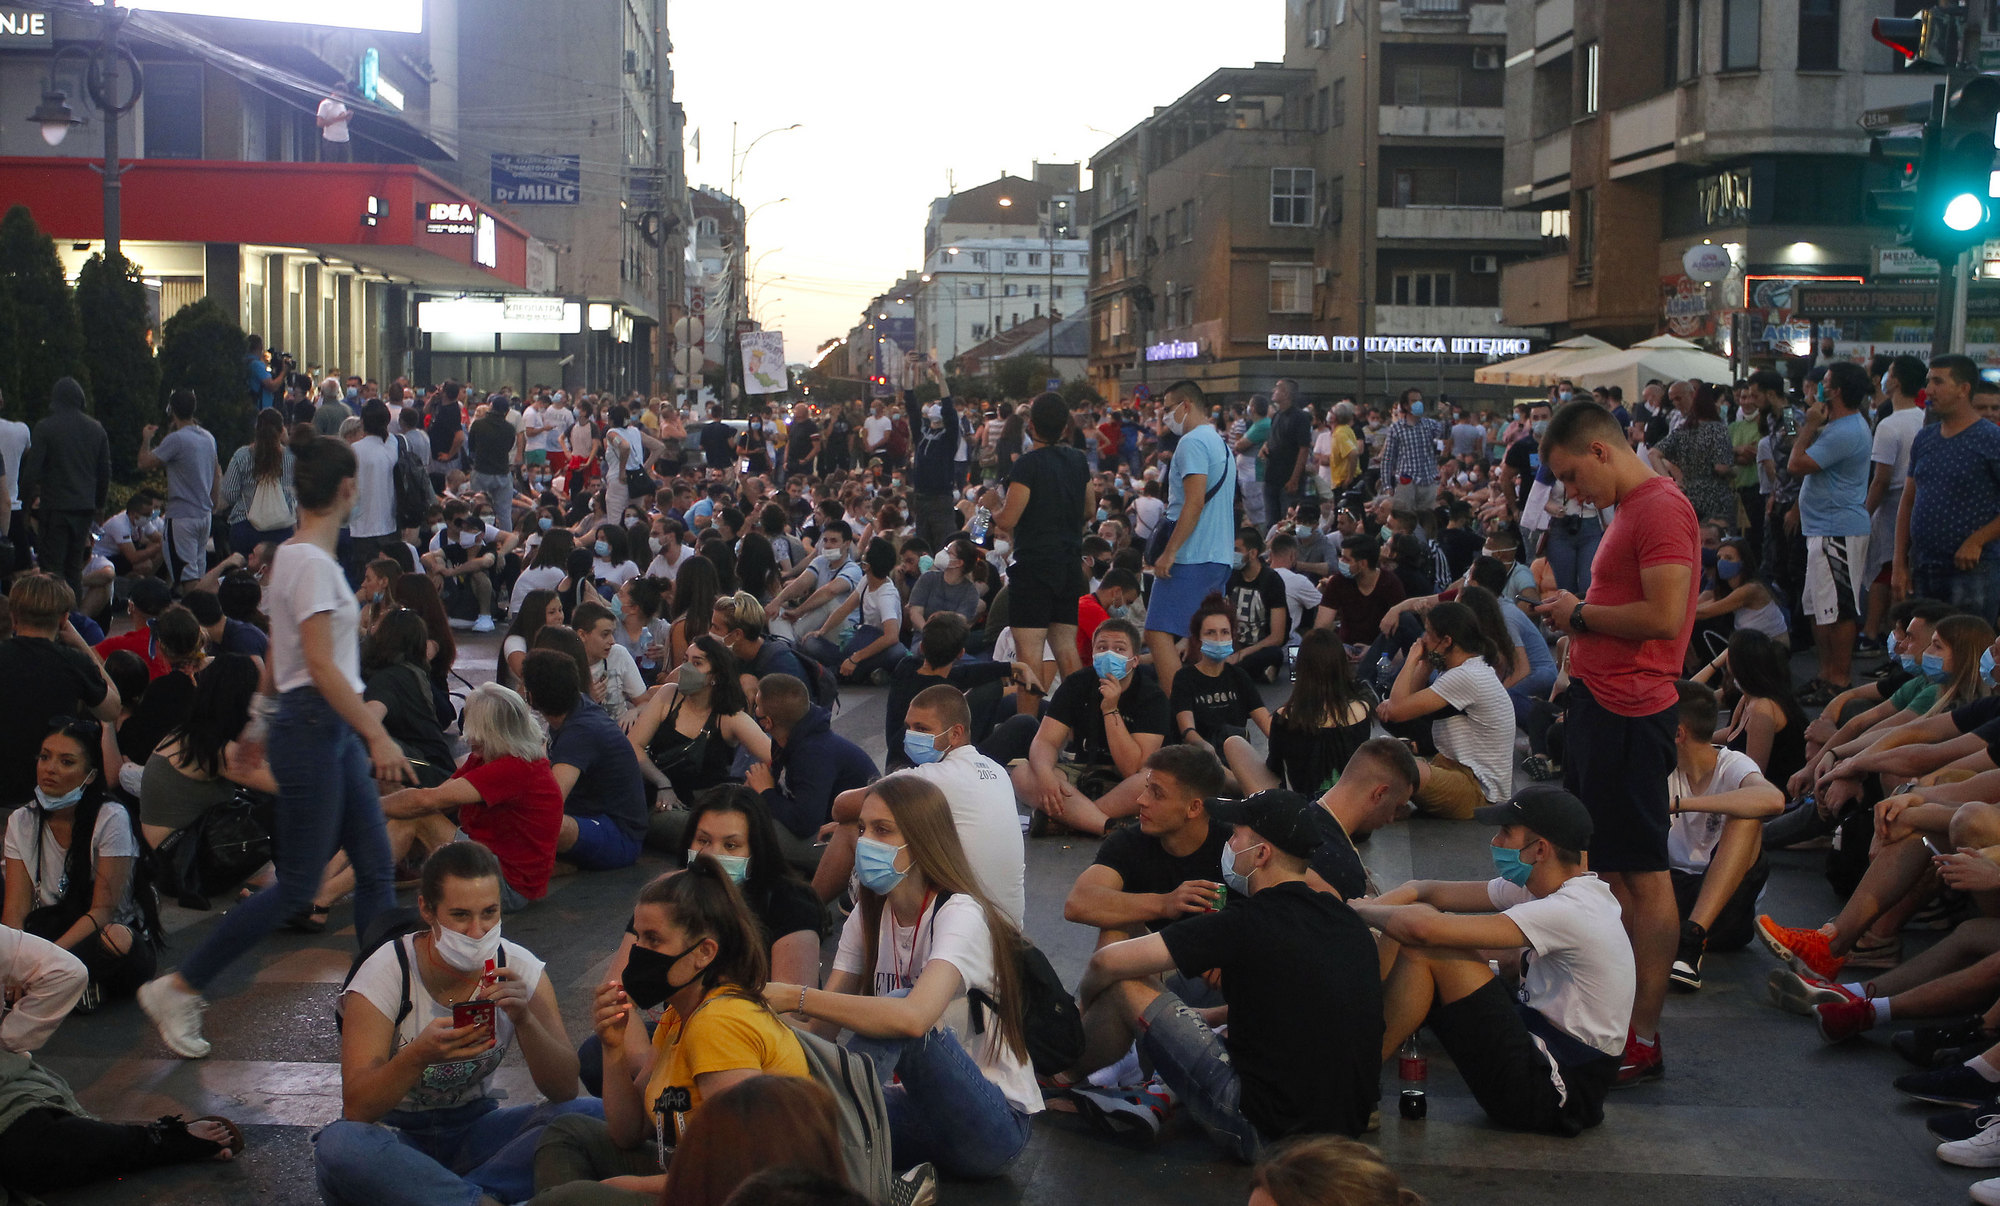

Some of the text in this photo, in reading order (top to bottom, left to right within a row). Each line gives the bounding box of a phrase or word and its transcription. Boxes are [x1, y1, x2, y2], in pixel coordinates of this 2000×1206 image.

[0, 12, 45, 35] NJE
[497, 188, 515, 200] Dr
[1267, 334, 1329, 351] БАНКА
[977, 769, 998, 780] 2015
